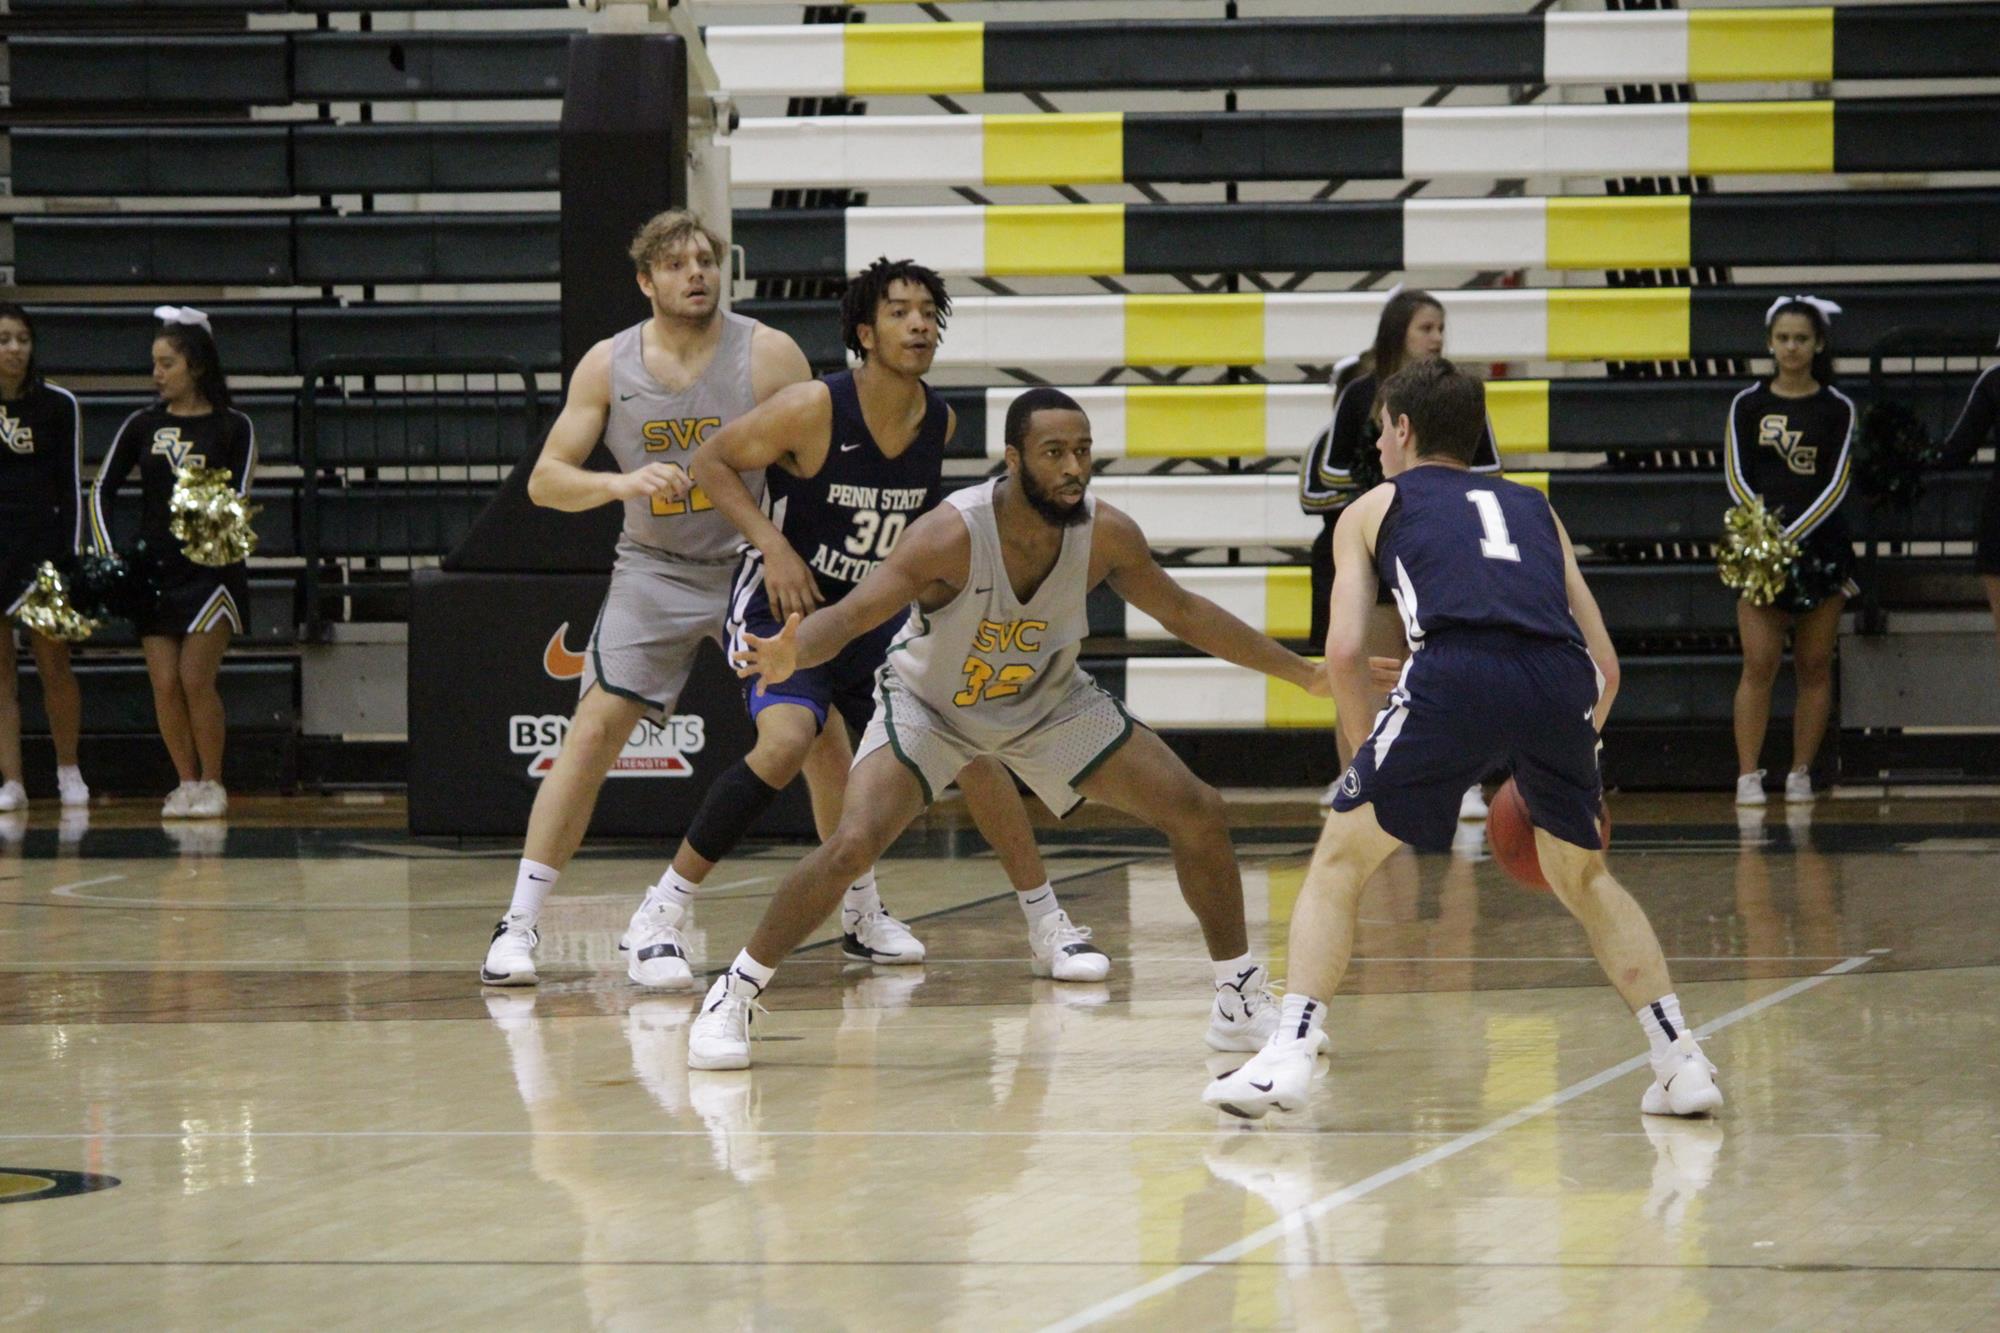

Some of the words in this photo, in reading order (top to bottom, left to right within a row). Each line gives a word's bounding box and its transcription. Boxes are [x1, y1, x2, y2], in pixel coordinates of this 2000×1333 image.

[0, 405, 34, 454] VC
[642, 416, 721, 453] SVC
[1758, 414, 1817, 475] SVC
[827, 483, 879, 509] PENN
[881, 487, 928, 511] STATE
[844, 509, 907, 559] 30
[1465, 489, 1521, 562] 1
[809, 543, 881, 583] ALTO
[972, 618, 1048, 652] SVC
[952, 654, 1036, 708] 32
[516, 722, 570, 747] BS
[626, 721, 699, 747] ORTS
